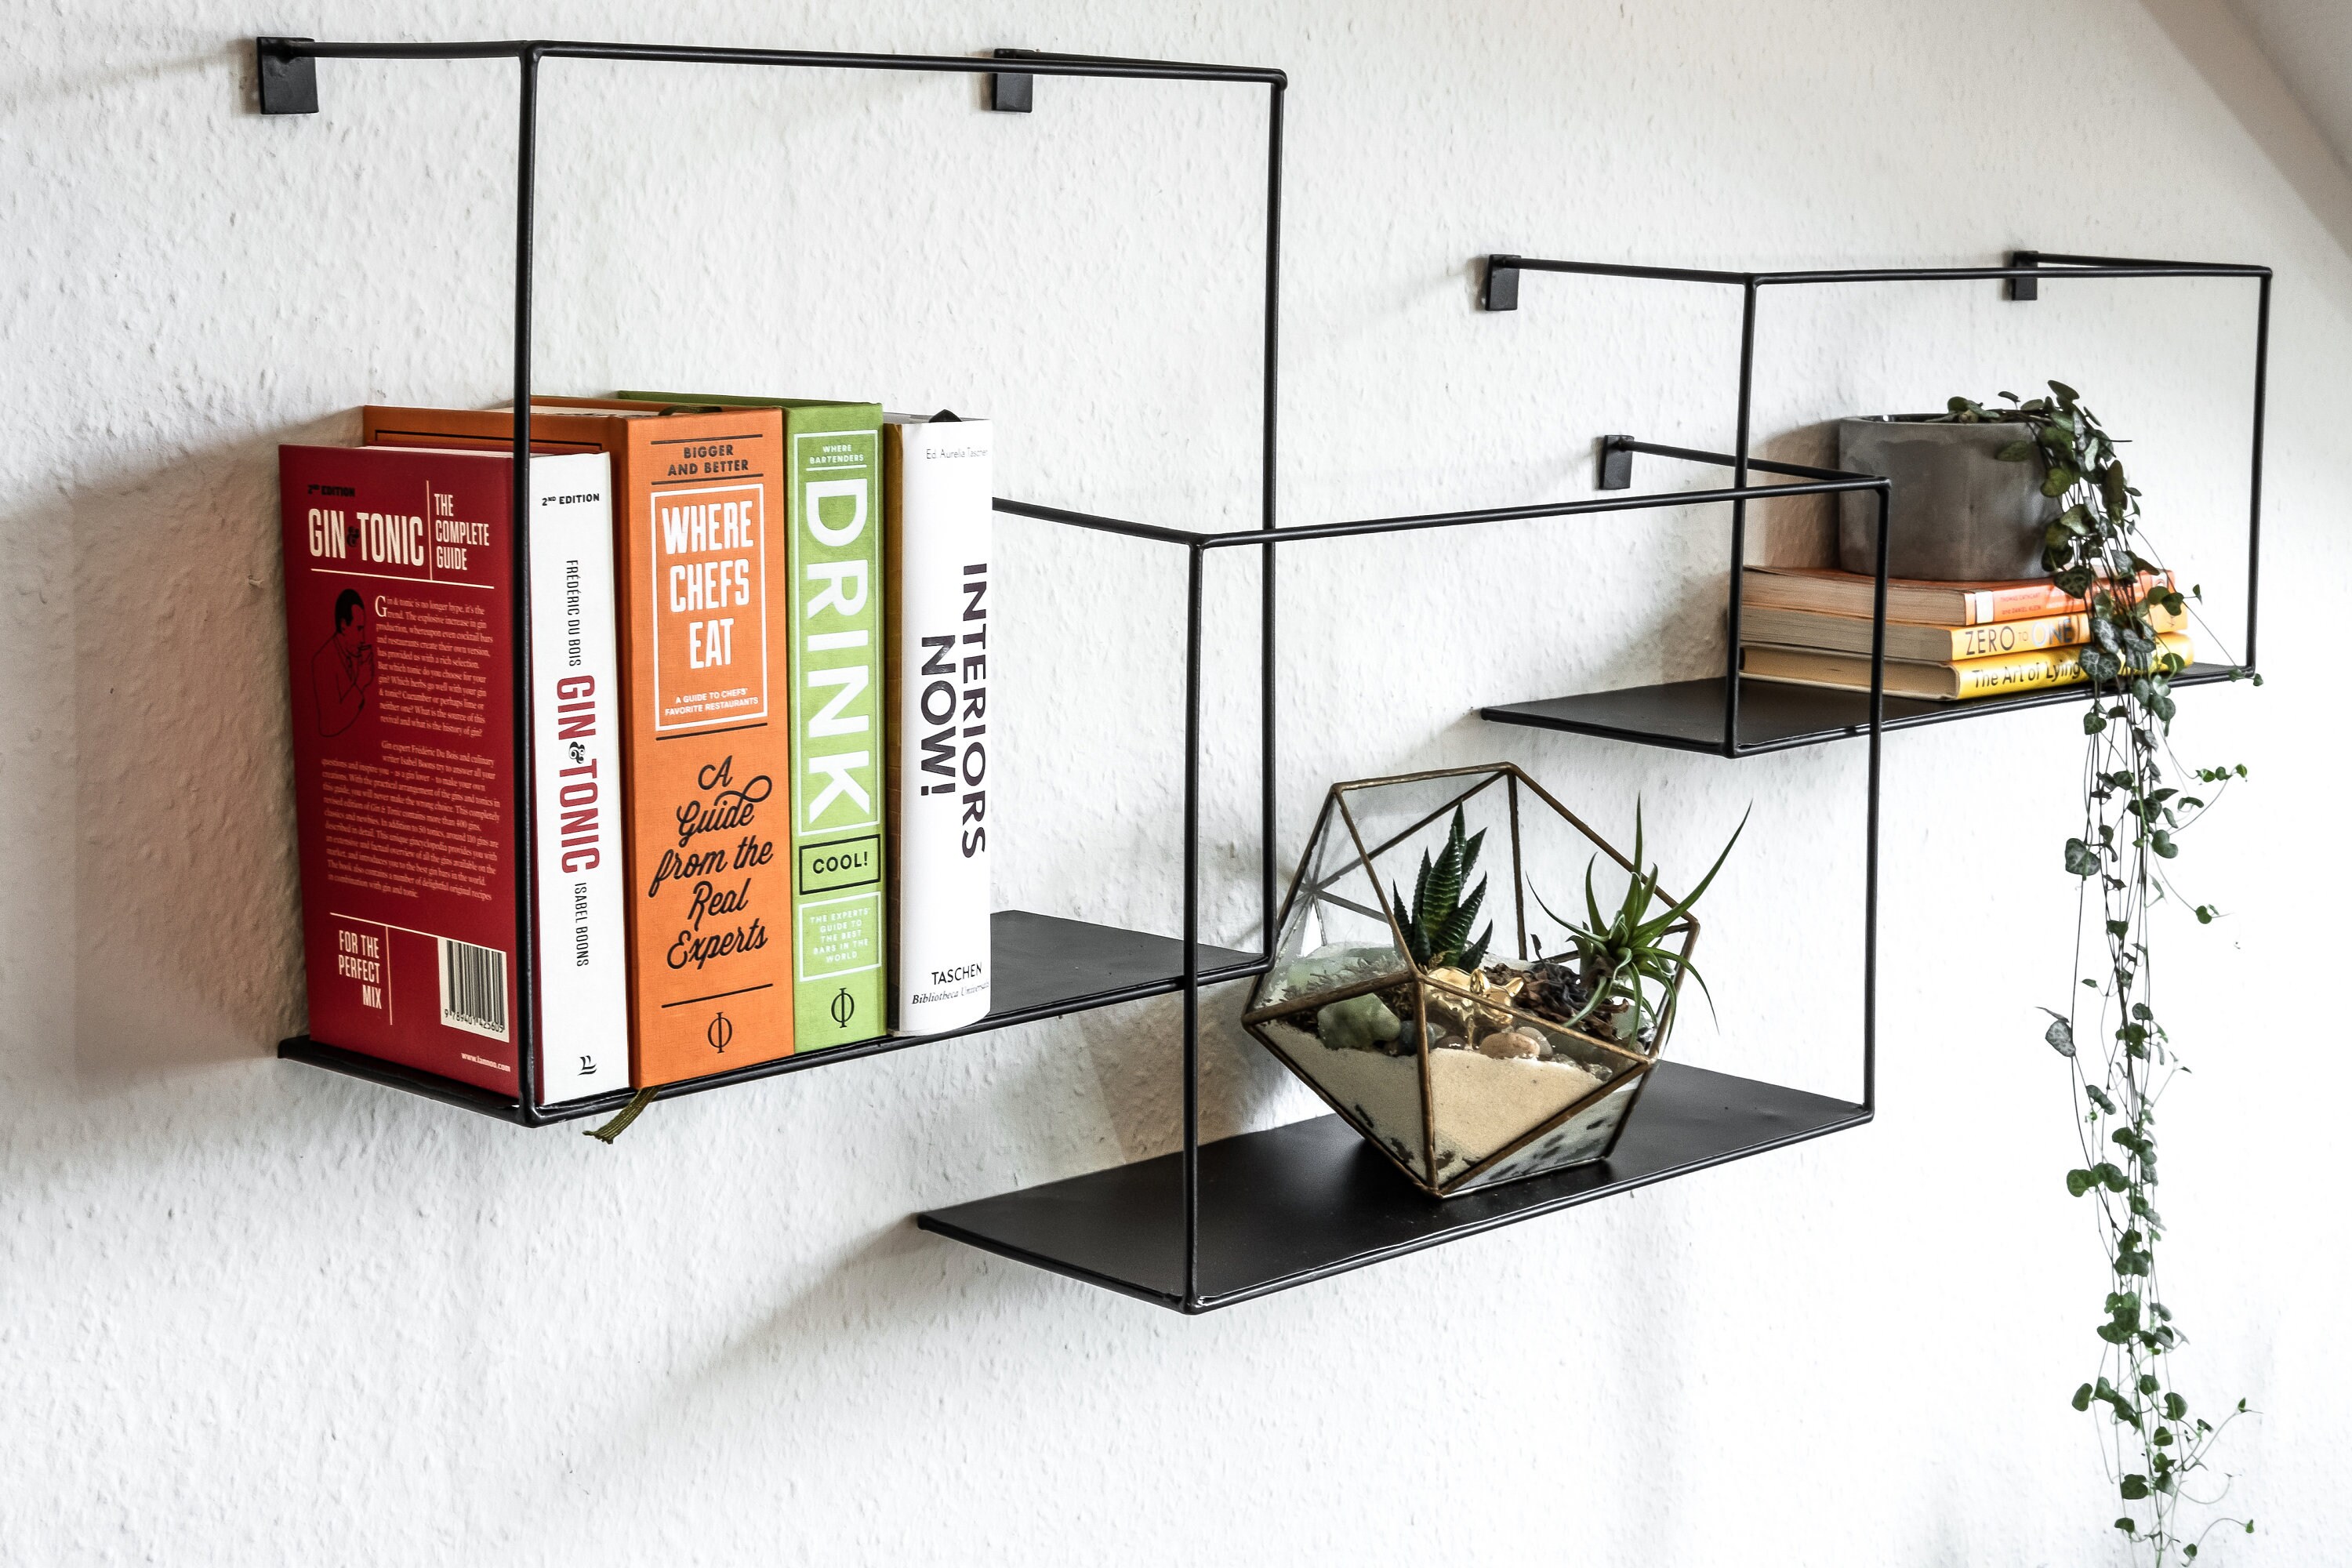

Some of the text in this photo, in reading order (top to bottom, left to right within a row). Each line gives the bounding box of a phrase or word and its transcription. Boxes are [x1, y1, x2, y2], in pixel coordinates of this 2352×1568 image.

[684, 445, 734, 459] BIGGER
[809, 453, 865, 465] BARTENDERS
[822, 444, 853, 454] WHERE
[667, 459, 750, 477] AND BETTER
[321, 485, 356, 497] EDITION
[542, 492, 601, 506] 2ND EDITION
[434, 493, 454, 517] THE
[308, 508, 424, 567] GIN & TONIC
[435, 519, 490, 546] COMPLETE
[661, 500, 755, 555] WHERE
[436, 546, 468, 571] GUIDE
[670, 558, 751, 613] CHEFS
[566, 559, 583, 666] FRÉDÉRIC DU BOIS
[689, 617, 735, 670] EAT
[1965, 618, 2073, 655] ZERO TO ONE
[806, 478, 870, 825] DRINK
[1972, 659, 2081, 688] The Art of Lying
[665, 697, 759, 716] FAVORITE RESTAURANTS
[683, 693, 707, 703] GUIDE
[962, 563, 988, 858] INTERIORS
[920, 634, 956, 797] NOW!
[557, 675, 601, 873] GIN & TONIC
[697, 755, 734, 790] A
[677, 775, 773, 848] Guide
[648, 834, 775, 898] from the
[812, 851, 869, 875] COOL!
[687, 877, 752, 932] Real
[574, 882, 590, 967] ISABEL BOONS
[810, 914, 827, 924] THE
[820, 919, 862, 933] GUIDE TO
[339, 930, 379, 960] FOR THE
[666, 918, 769, 971] Experts
[813, 944, 837, 955] BARS
[852, 938, 869, 948] THE
[821, 929, 862, 943] THE BEST
[338, 954, 380, 984] PERFECT
[826, 951, 858, 963] WORLD
[931, 961, 982, 985] TASCHEN
[362, 984, 383, 1010] MIX
[912, 990, 959, 1004] Bibliotheca
